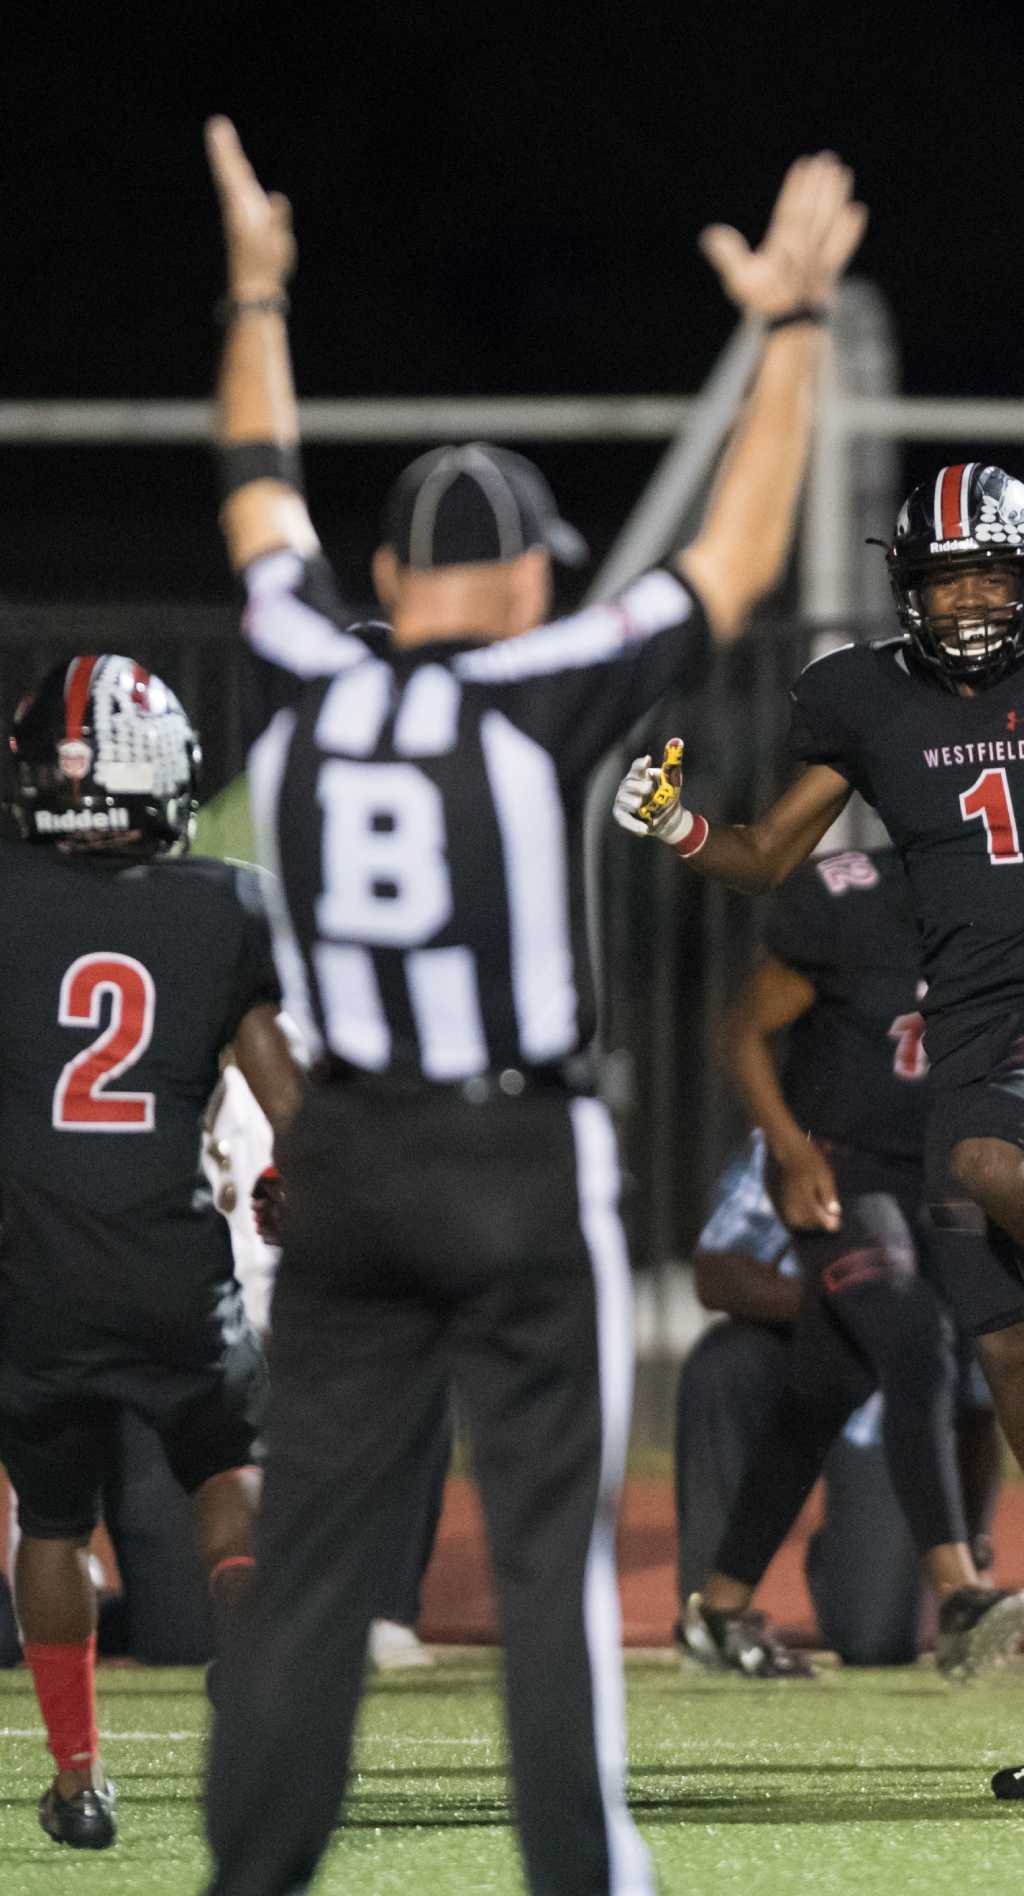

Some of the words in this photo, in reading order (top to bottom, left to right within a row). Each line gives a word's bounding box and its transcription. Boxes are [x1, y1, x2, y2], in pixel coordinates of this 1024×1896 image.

[34, 807, 130, 834] Riddell
[316, 760, 453, 948] B
[958, 767, 1024, 865] 1
[52, 952, 156, 1132] 2
